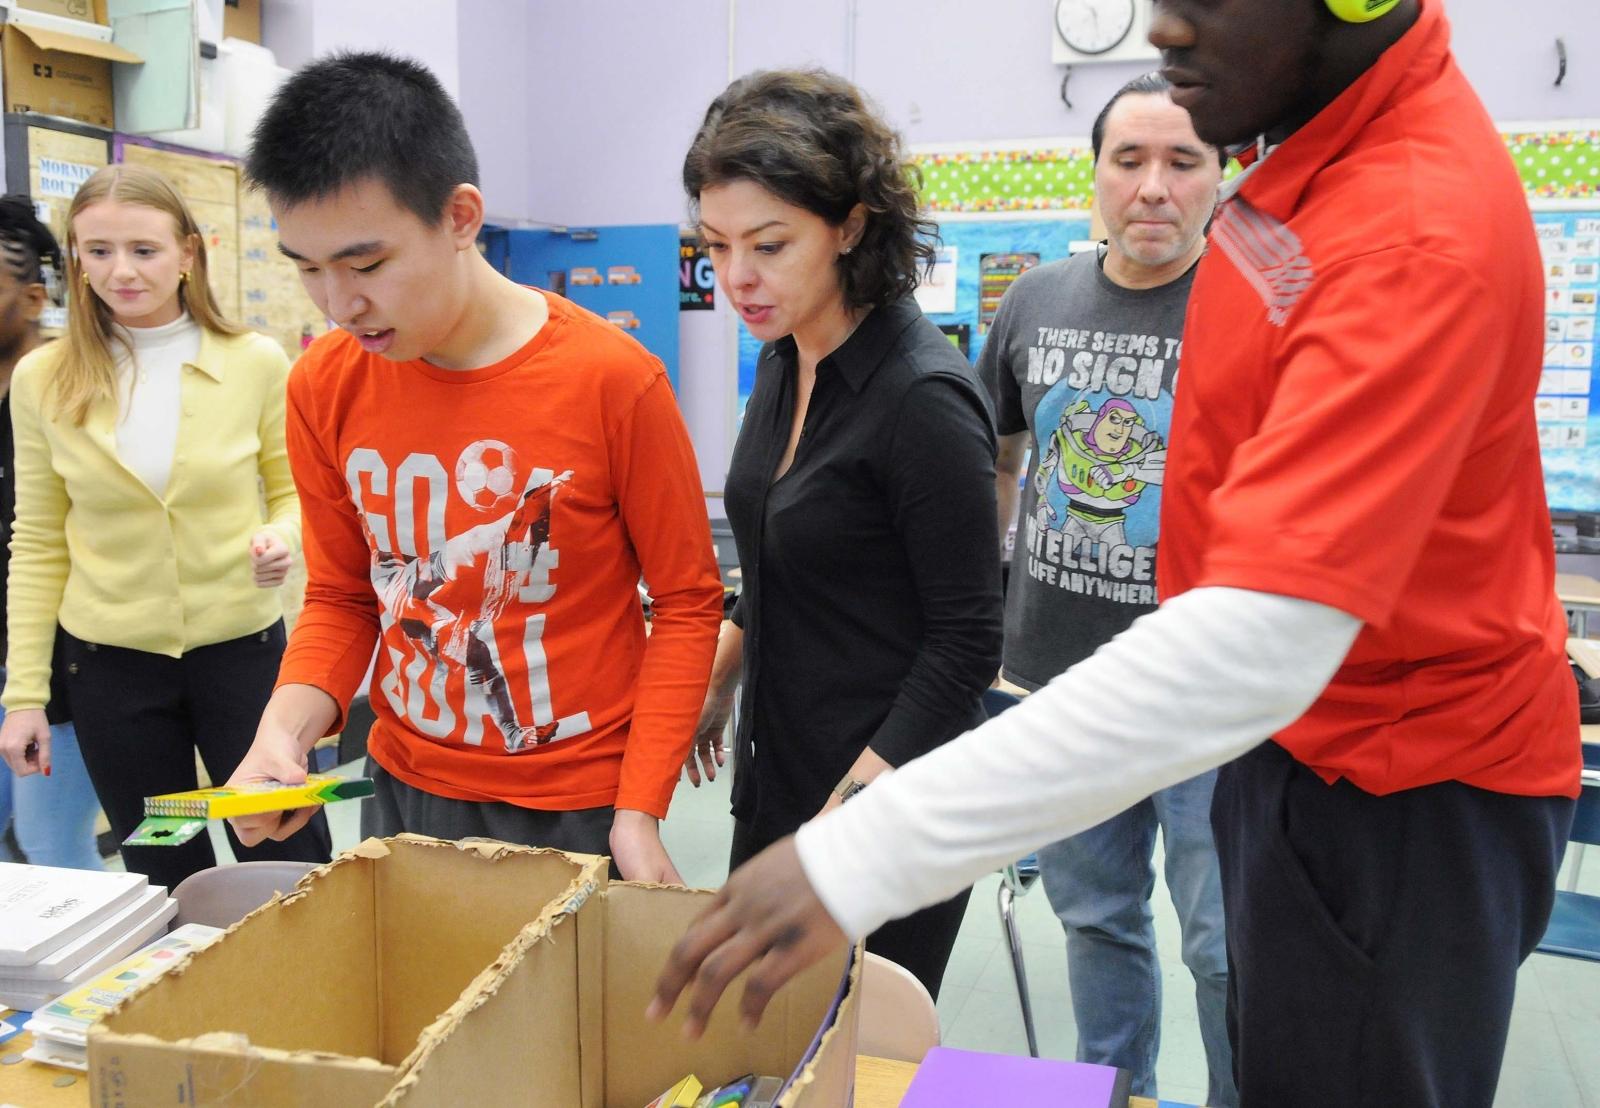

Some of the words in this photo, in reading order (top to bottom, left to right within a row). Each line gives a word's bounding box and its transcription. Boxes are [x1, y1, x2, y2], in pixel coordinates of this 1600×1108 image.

[1038, 326, 1090, 349] THERE
[1092, 331, 1159, 357] SEEMS
[1027, 346, 1065, 386] NO
[1067, 351, 1165, 400] SIGN
[1028, 555, 1057, 585] LIFE
